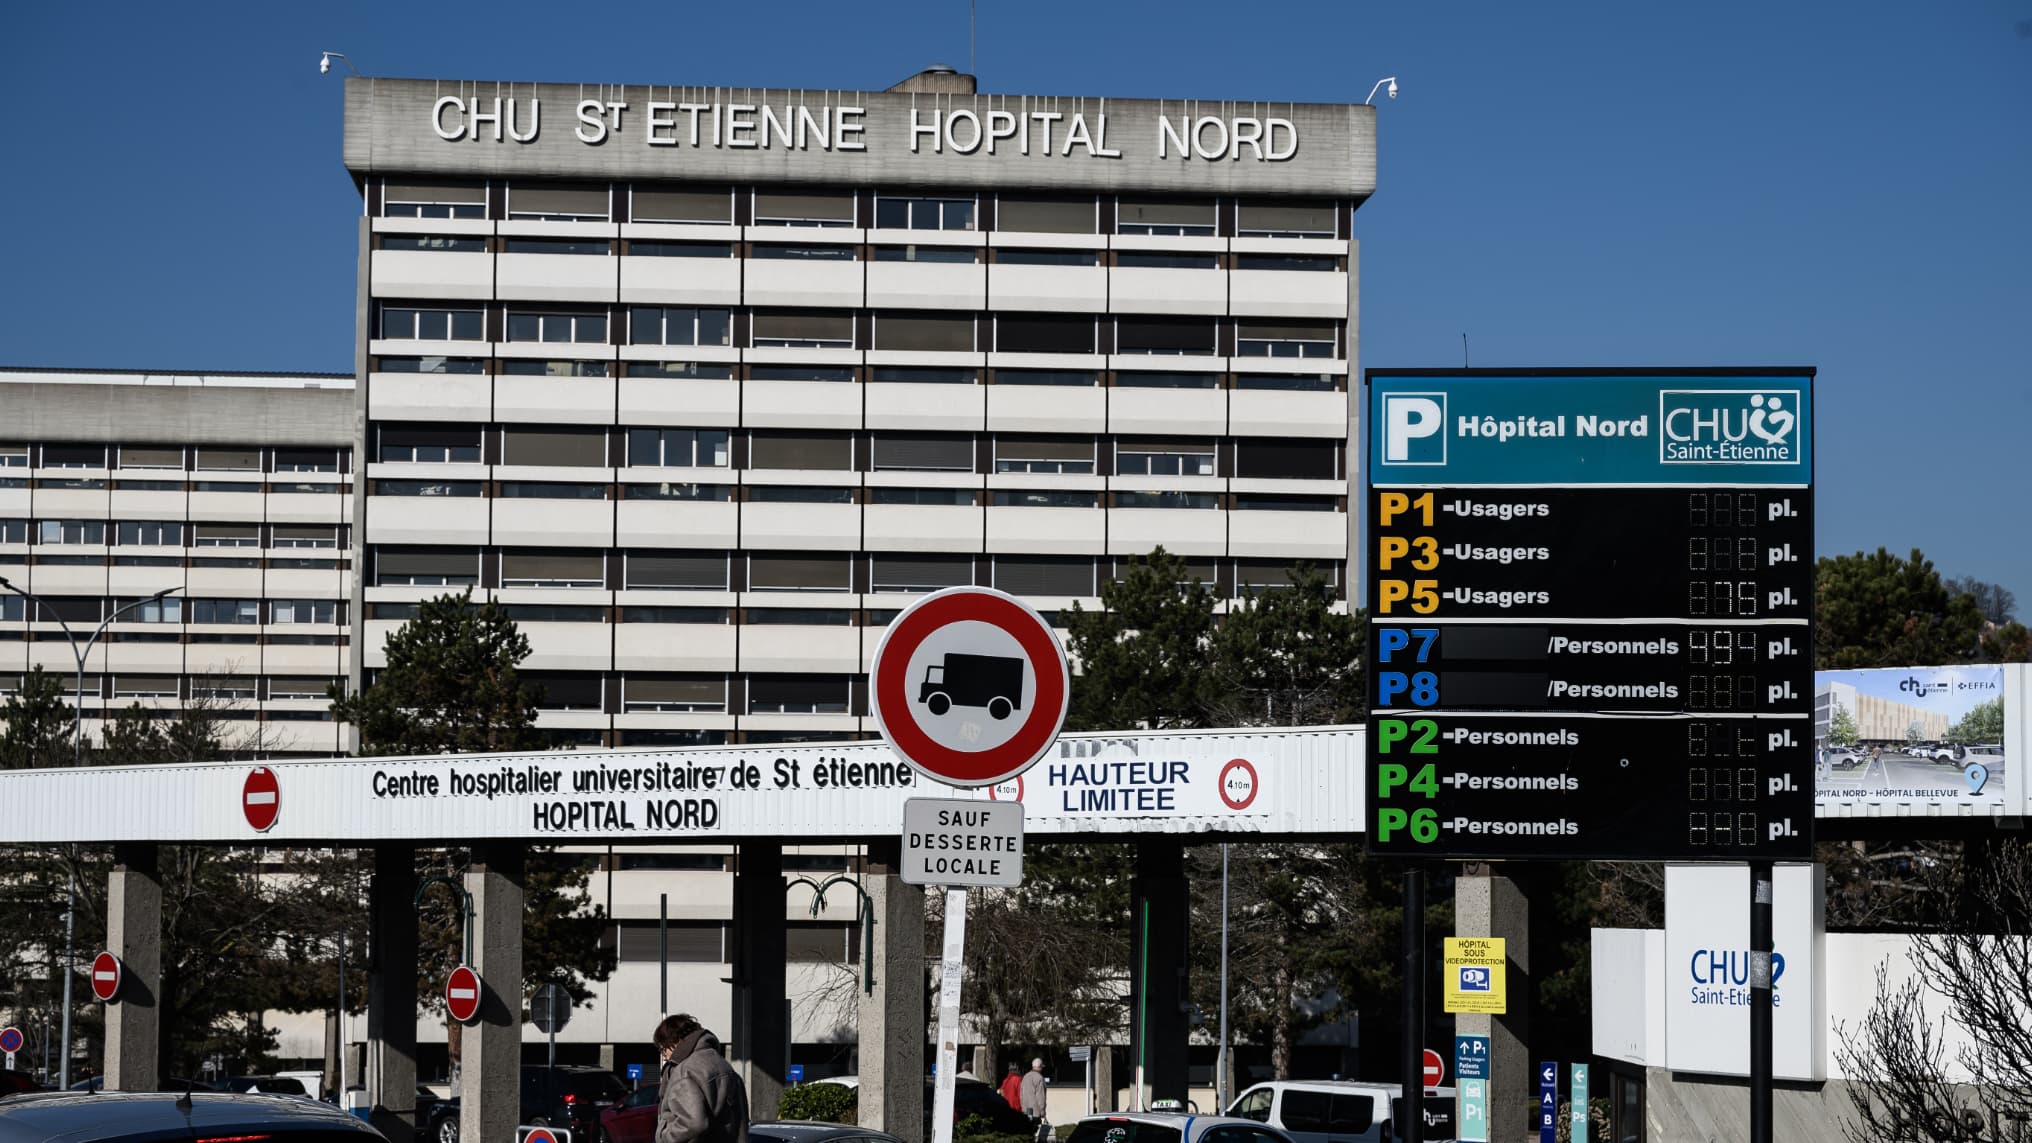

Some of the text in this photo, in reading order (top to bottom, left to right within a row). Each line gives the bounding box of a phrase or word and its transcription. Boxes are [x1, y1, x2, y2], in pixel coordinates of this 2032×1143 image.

[431, 95, 540, 143] CHU
[646, 101, 867, 152] ETIENNE
[909, 110, 1121, 157] HOPITAL
[1158, 115, 1298, 162] NORD
[1387, 398, 1441, 460] P
[1458, 415, 1649, 443] Hôpital Nord
[1666, 408, 1748, 442] CHU
[1667, 440, 1789, 460] Saint-Étienne
[1379, 493, 1434, 526] P1
[1768, 499, 1798, 521] pl.
[1379, 536, 1439, 570] P3
[1768, 543, 1798, 566] pl.
[1379, 580, 1439, 614] P5
[1768, 587, 1798, 609] pl.
[1379, 628, 1439, 663] P7
[1768, 637, 1798, 659] pl.
[1379, 671, 1439, 706] P8
[1768, 681, 1798, 703] pl.
[1900, 676, 1926, 697] chu
[1968, 682, 1996, 690] EFFIA
[1379, 719, 1439, 753] P2
[1768, 729, 1798, 751] pl.
[372, 757, 914, 800] Centre hospitalier universitaire de St étienne
[1049, 761, 1190, 787] HAUTEUR
[1379, 764, 1439, 798] P4
[1768, 773, 1798, 795] pl.
[1064, 787, 1175, 812] LIMITEE
[1815, 789, 1840, 797] PITAL
[1842, 789, 1867, 797] NORD
[1915, 789, 1959, 797] BELLEVUE
[533, 799, 718, 831] HOPITAL NORD
[938, 810, 991, 827] SAUF
[1379, 808, 1439, 843] P6
[1768, 818, 1798, 840] pl.
[910, 833, 1017, 852] DESSERTE
[924, 857, 1001, 876] LOCALE
[1464, 949, 1486, 957] SOUS
[1691, 949, 1748, 985] CHU
[1691, 986, 1780, 1007] Saint-Etiee
[1466, 1103, 1482, 1120] P1
[1543, 1092, 1553, 1104] A
[1424, 1108, 1435, 1126] hu
[1544, 1114, 1552, 1125] B
